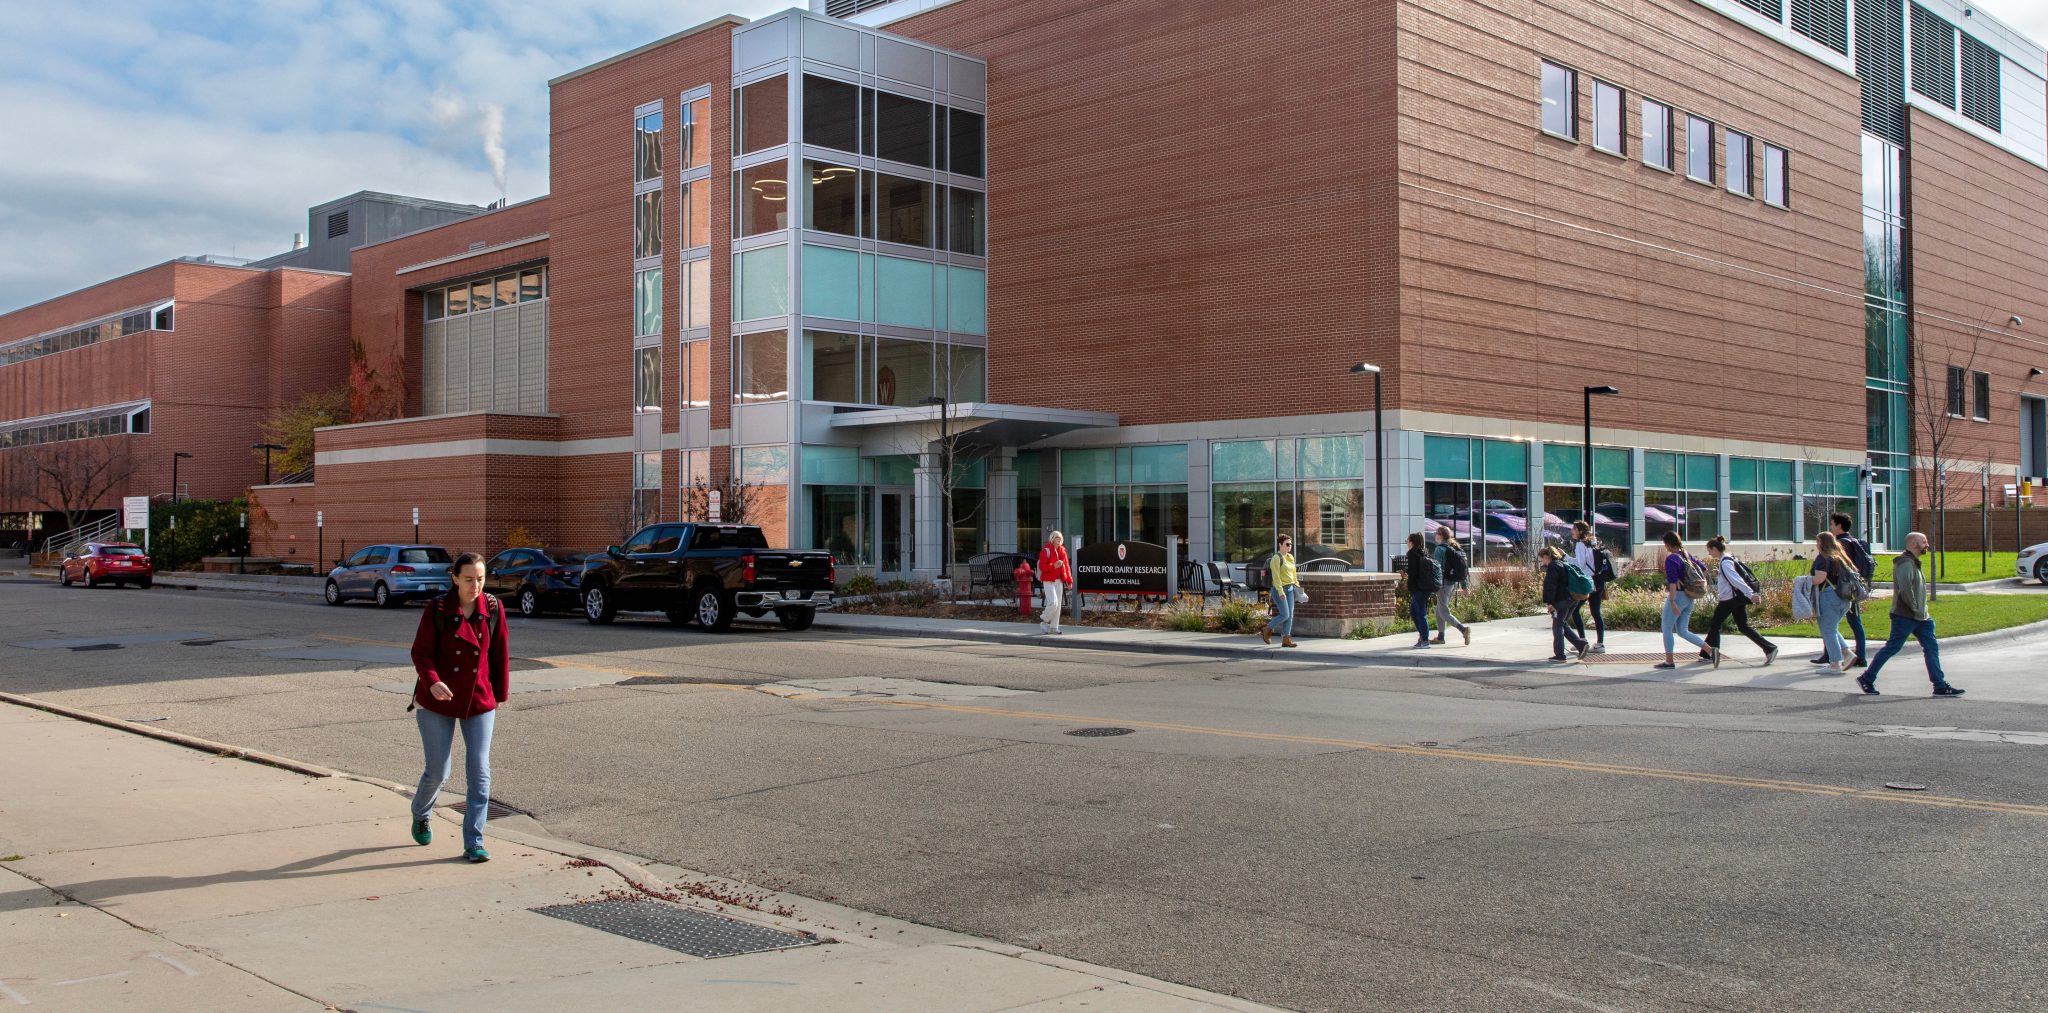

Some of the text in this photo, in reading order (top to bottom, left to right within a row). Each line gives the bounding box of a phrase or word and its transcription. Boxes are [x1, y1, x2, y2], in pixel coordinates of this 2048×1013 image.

[880, 382, 889, 402] W
[1115, 566, 1133, 574] DAIRY
[1135, 566, 1167, 574] RESEARCH
